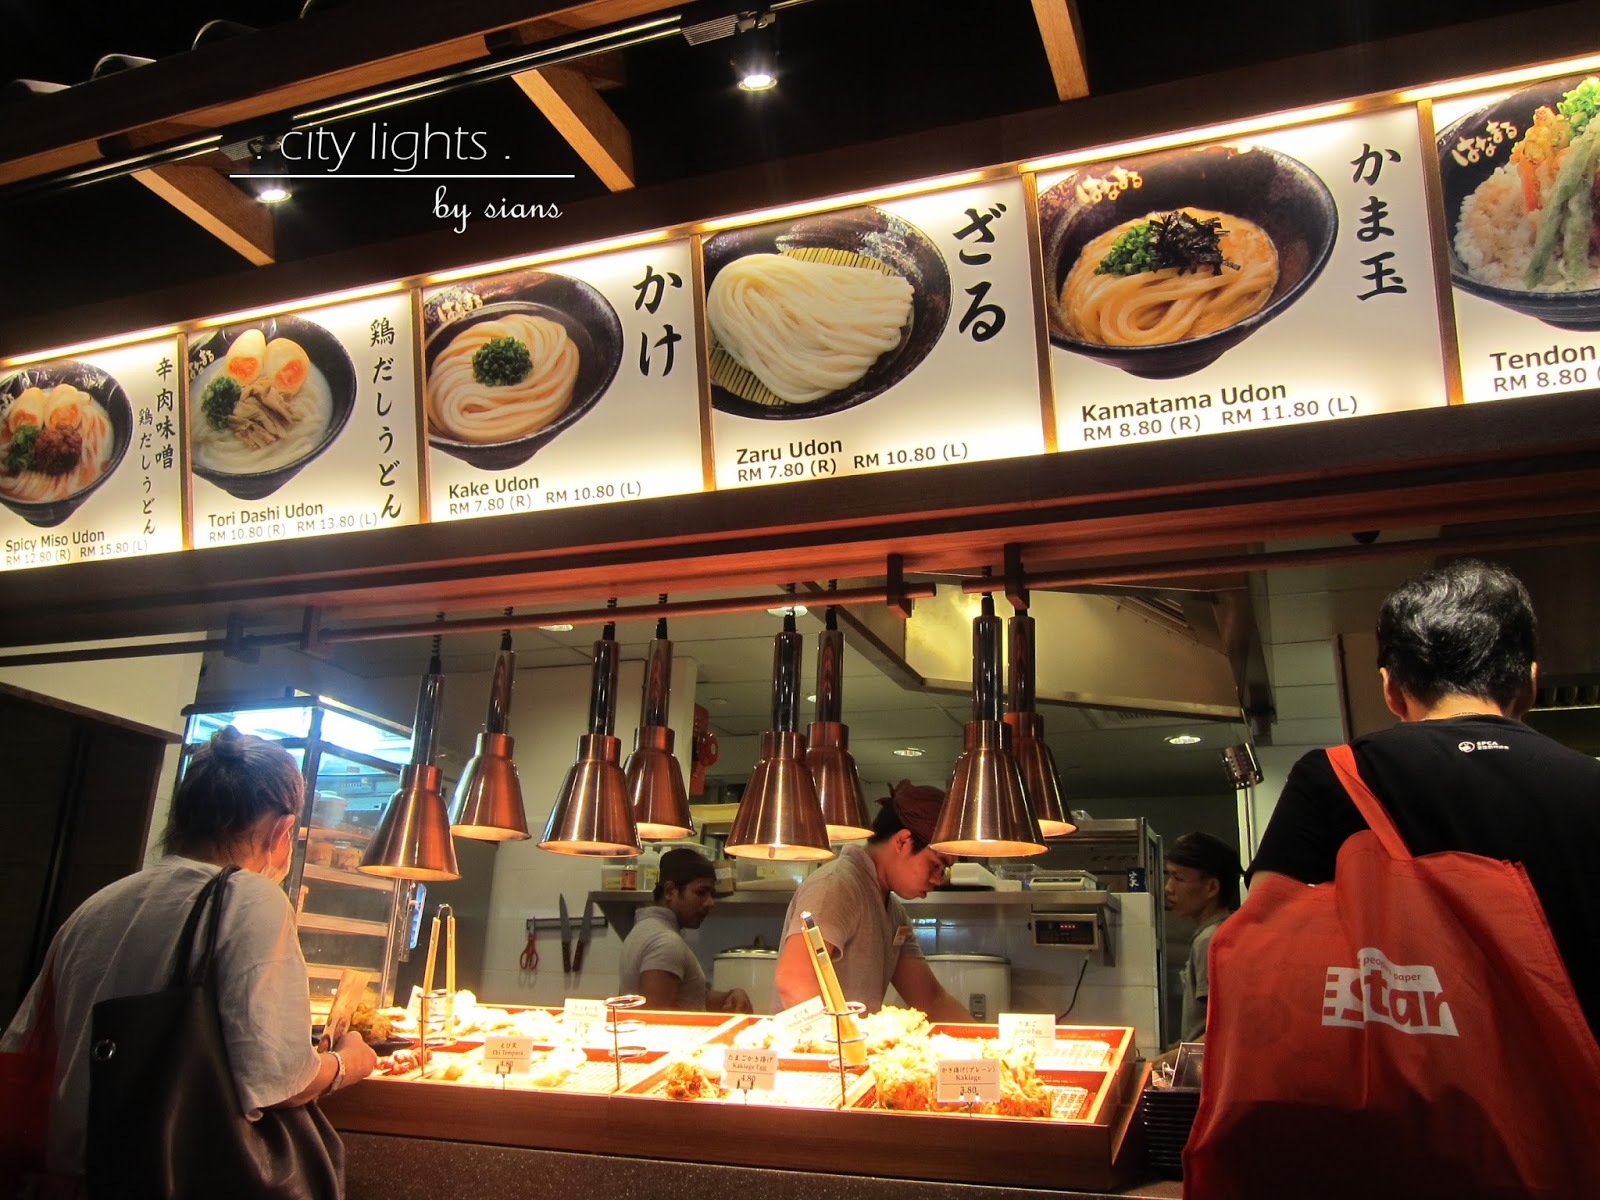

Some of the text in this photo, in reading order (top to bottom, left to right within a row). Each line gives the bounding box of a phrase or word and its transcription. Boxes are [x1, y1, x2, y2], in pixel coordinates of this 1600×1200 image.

[1452, 120, 1517, 167] はなまる
[1350, 143, 1408, 301] かま玉
[952, 203, 1007, 342] ざる
[633, 265, 683, 377] かけ
[1489, 345, 1596, 371] Tendon
[1494, 367, 1587, 392] RM 8.80
[155, 357, 176, 470] 辛肉味噌
[369, 317, 401, 519] 鶏だしうどん
[1081, 384, 1286, 422] Kamatama Udon
[1083, 395, 1357, 441] RM 8.80 (R) RM 11.80 (L)
[736, 439, 843, 464] Zaru Udon
[738, 442, 968, 482] RM 7.80 (R) RM 10.80 (L)
[138, 407, 156, 535] 鶏だしうどん
[449, 476, 539, 499] Kake Udon
[449, 481, 641, 515] RM 7.80 (R) RM 10.80 (L)
[208, 503, 323, 528] Tori Dashi Udon
[209, 512, 377, 542] RM 10.80 (R) RM 13.80 (L)
[6, 530, 105, 553] Spicy Miso Udon
[6, 554, 20, 566] RM
[55, 549, 71, 563] (R)
[80, 547, 96, 558] RM
[100, 542, 129, 556] 15.80
[132, 540, 148, 553] (L)
[732, 1063, 755, 1071] Kakiage
[741, 1074, 757, 1082] 4.80
[955, 1074, 982, 1082] Kakiage
[960, 1086, 977, 1094] 3.80
